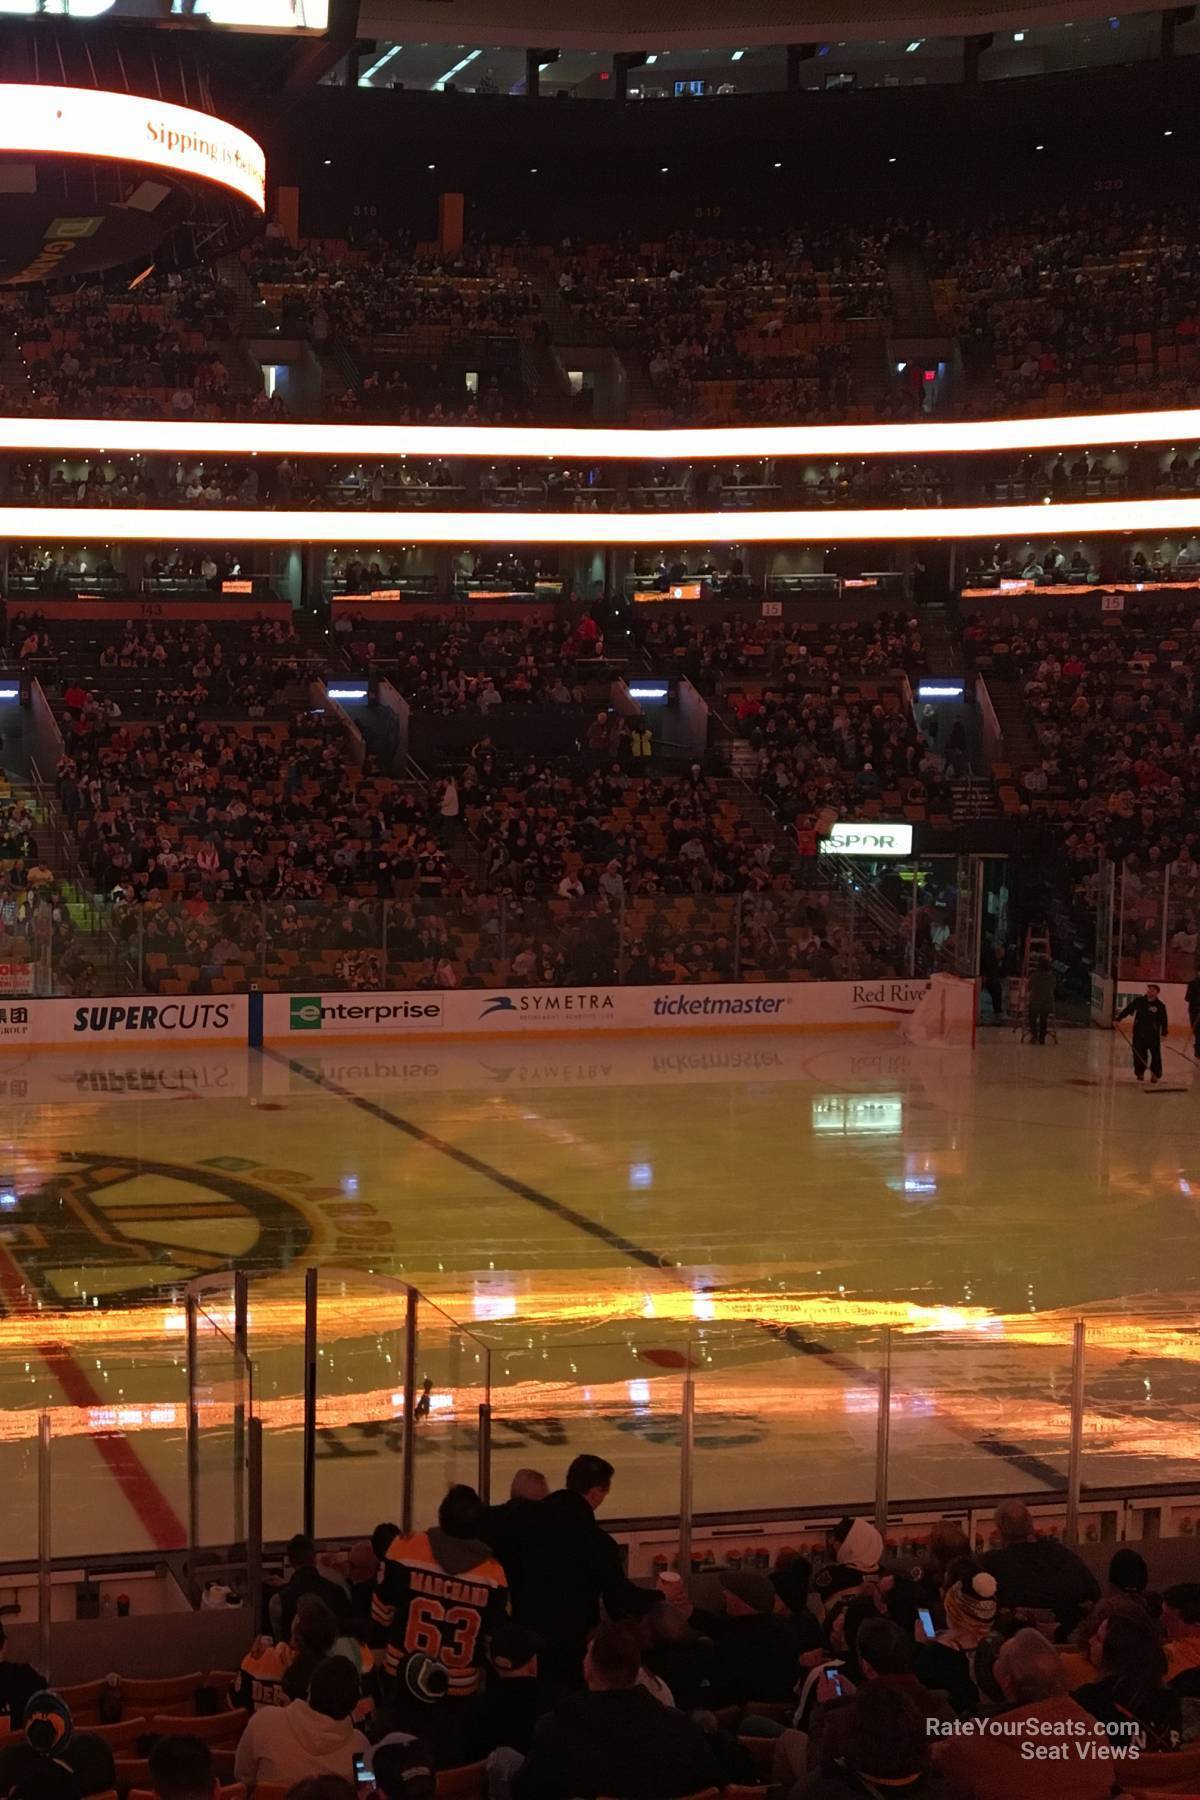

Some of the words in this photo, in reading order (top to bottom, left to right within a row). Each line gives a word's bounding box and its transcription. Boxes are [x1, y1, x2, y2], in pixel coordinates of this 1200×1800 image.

[147, 121, 217, 161] Sipping
[141, 604, 162, 616] 143
[1104, 598, 1120, 609] 15
[520, 995, 614, 1011] SYMETRA
[853, 984, 888, 1004] Red
[890, 983, 927, 1001] Rive
[298, 1000, 440, 1023] enterprise
[653, 995, 785, 1017] ticketmaster
[74, 1004, 230, 1031] SUPERCUTS
[408, 1571, 490, 1607] MARCHAND
[404, 1596, 482, 1667] 63
